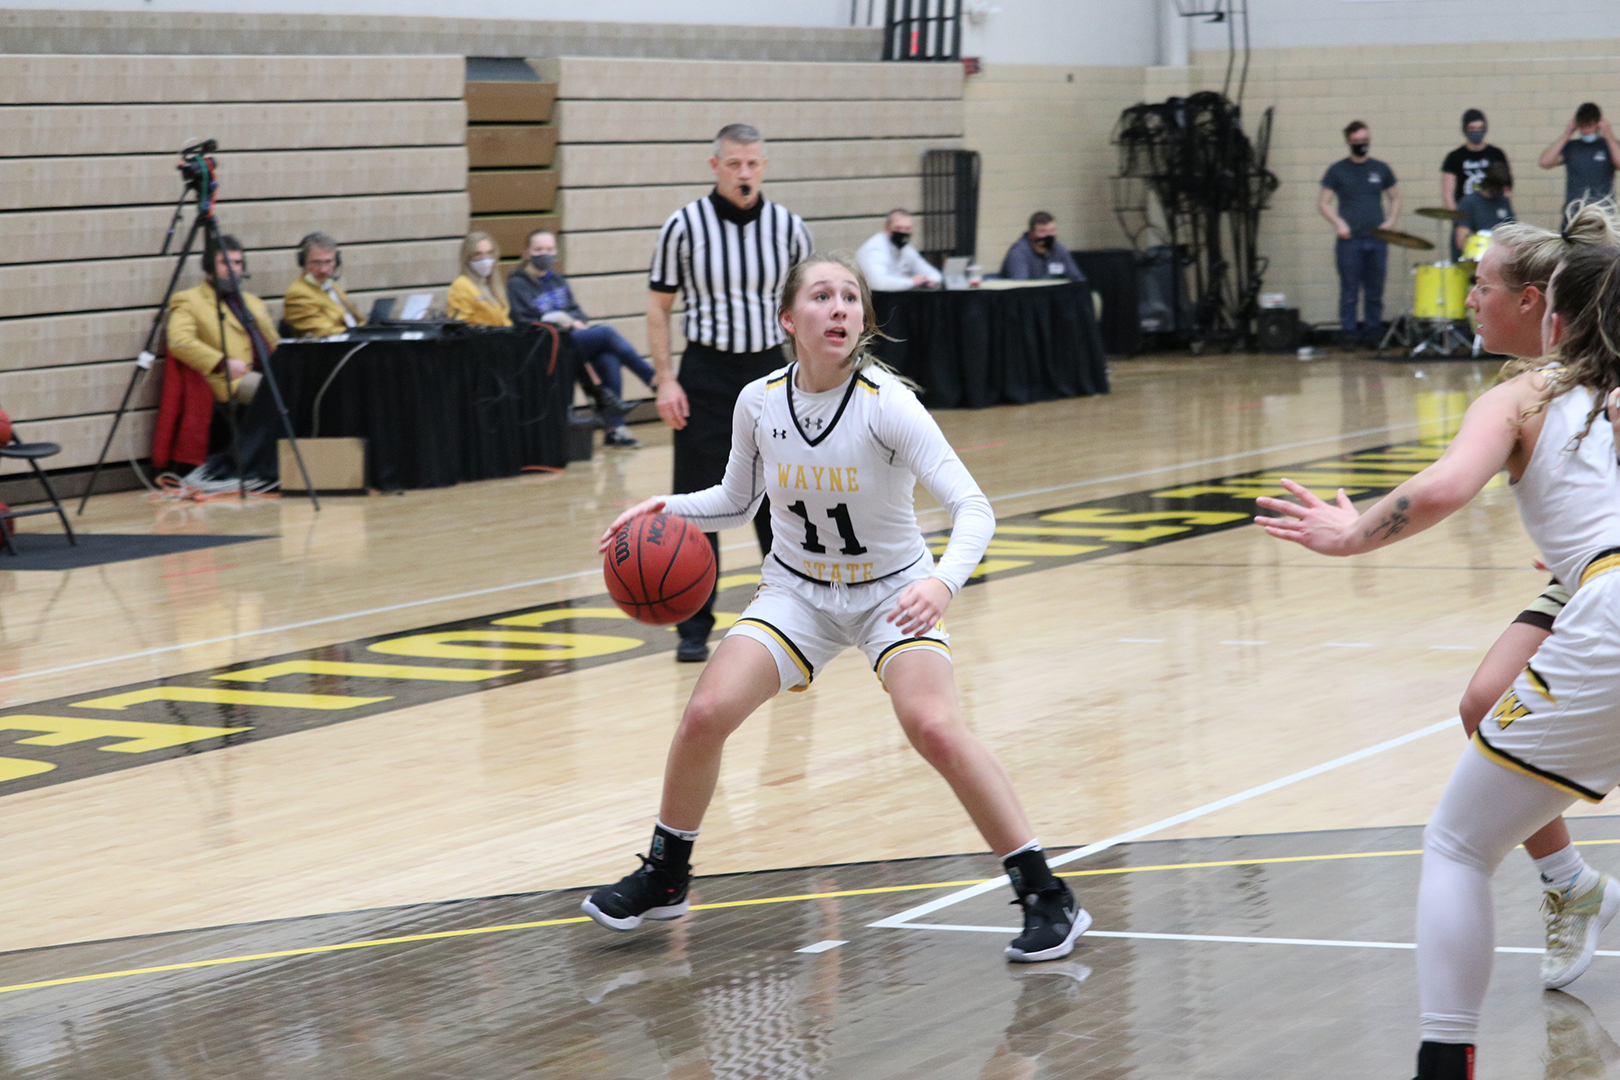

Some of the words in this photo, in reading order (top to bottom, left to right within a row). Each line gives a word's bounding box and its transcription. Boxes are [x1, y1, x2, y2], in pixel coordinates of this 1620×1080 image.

[777, 462, 859, 492] WAYNE
[787, 500, 867, 556] 11
[803, 560, 873, 583] STATE
